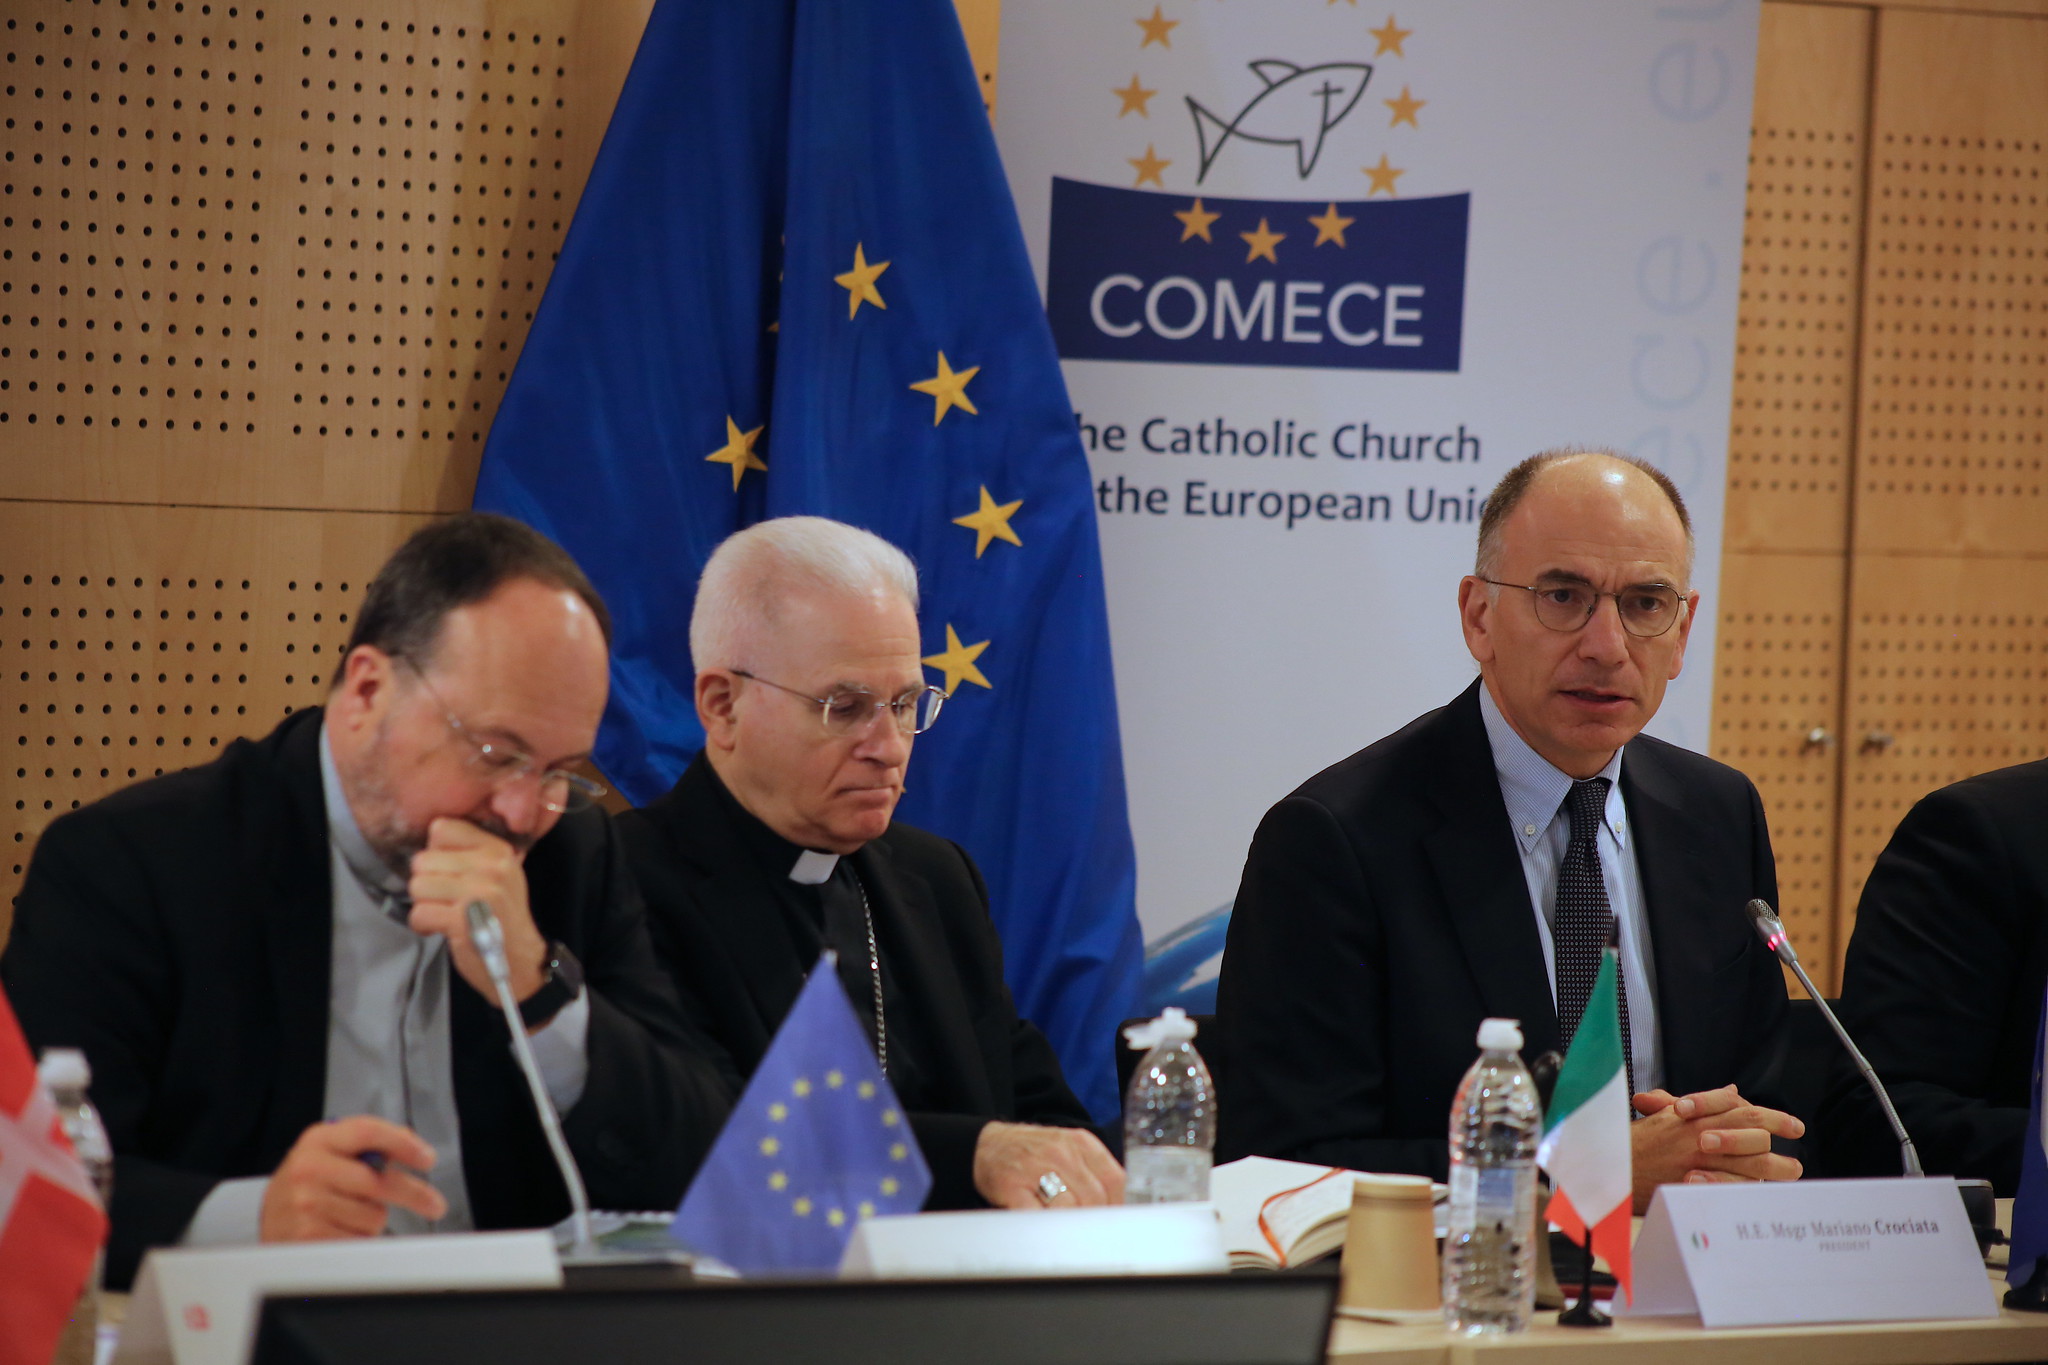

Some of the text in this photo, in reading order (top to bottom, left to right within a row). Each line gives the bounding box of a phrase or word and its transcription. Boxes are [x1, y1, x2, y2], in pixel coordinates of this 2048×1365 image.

[1090, 273, 1425, 347] COMECE
[1075, 412, 1482, 462] he Catholic Church
[1097, 475, 1490, 530] the European Uni
[1809, 1219, 1872, 1238] Mariano
[1873, 1216, 1940, 1236] Crociata
